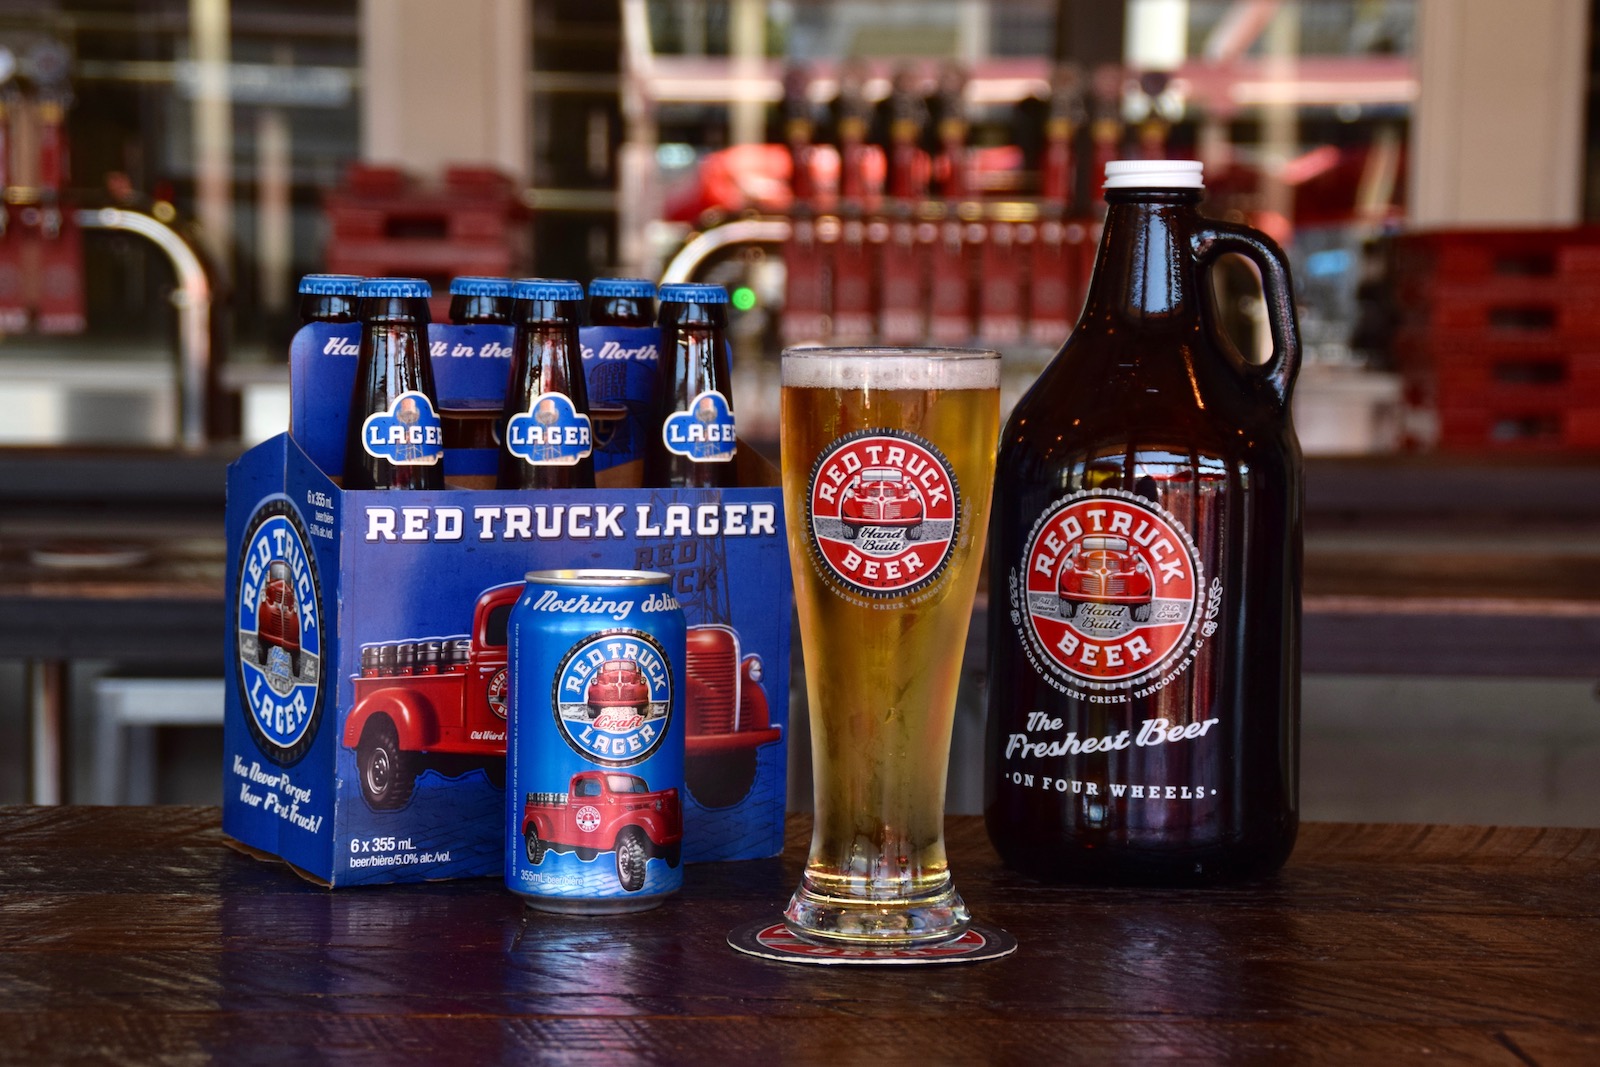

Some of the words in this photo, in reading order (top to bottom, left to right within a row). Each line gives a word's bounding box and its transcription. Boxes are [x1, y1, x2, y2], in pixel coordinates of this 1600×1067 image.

[451, 343, 474, 358] in
[479, 342, 512, 358] the
[511, 426, 590, 446] LAGER
[819, 451, 863, 505] RED
[865, 445, 948, 508] TRUCK
[315, 492, 326, 507] 355
[365, 506, 464, 541] RED
[473, 505, 625, 540] TRUCK
[635, 503, 777, 538] LAGER
[860, 526, 904, 540] Hand
[635, 540, 698, 570] RED
[861, 539, 903, 551] Built
[1035, 515, 1083, 578] RED
[1086, 509, 1186, 585] TRUCK
[841, 550, 925, 581] BEER
[243, 535, 272, 614] RED
[272, 528, 316, 633] TRUCK
[806, 546, 830, 587] HISTORIC
[830, 586, 870, 609] BREWERY
[846, 571, 922, 588] COMPANY
[533, 590, 635, 621] Nothing
[1031, 602, 1058, 613] Natural
[1039, 596, 1052, 605] All
[1081, 603, 1126, 617] Hand
[1081, 616, 1124, 630] Built
[1157, 611, 1182, 619] Craft
[1056, 630, 1152, 668] BEER
[565, 648, 606, 694] RED
[607, 642, 667, 692] TRUCK
[1017, 628, 1044, 675] HISTORIC
[1043, 673, 1087, 701] BREWERY
[1133, 657, 1193, 699] VANCOUVER
[1190, 638, 1205, 657] B.C.
[491, 673, 506, 692] RED
[251, 674, 308, 735] LAGER
[593, 714, 644, 729] Craft
[1026, 711, 1064, 732] The
[470, 730, 483, 740] Old
[482, 730, 505, 741] Weird
[578, 724, 656, 755] LAGER
[1005, 730, 1131, 760] Freshest
[1135, 717, 1220, 747] Beer
[233, 754, 249, 778] You
[249, 761, 280, 788] Never
[280, 773, 312, 805] Forget
[1042, 776, 1099, 796] FOUR
[1109, 783, 1206, 800] WHEELS
[240, 783, 263, 808] Your
[289, 804, 323, 834] Truck!
[350, 838, 360, 853] 6
[361, 841, 370, 852] x
[372, 837, 396, 852] 355
[350, 853, 419, 868] beer/bière/5.0%
[546, 873, 584, 886] beer/bière
